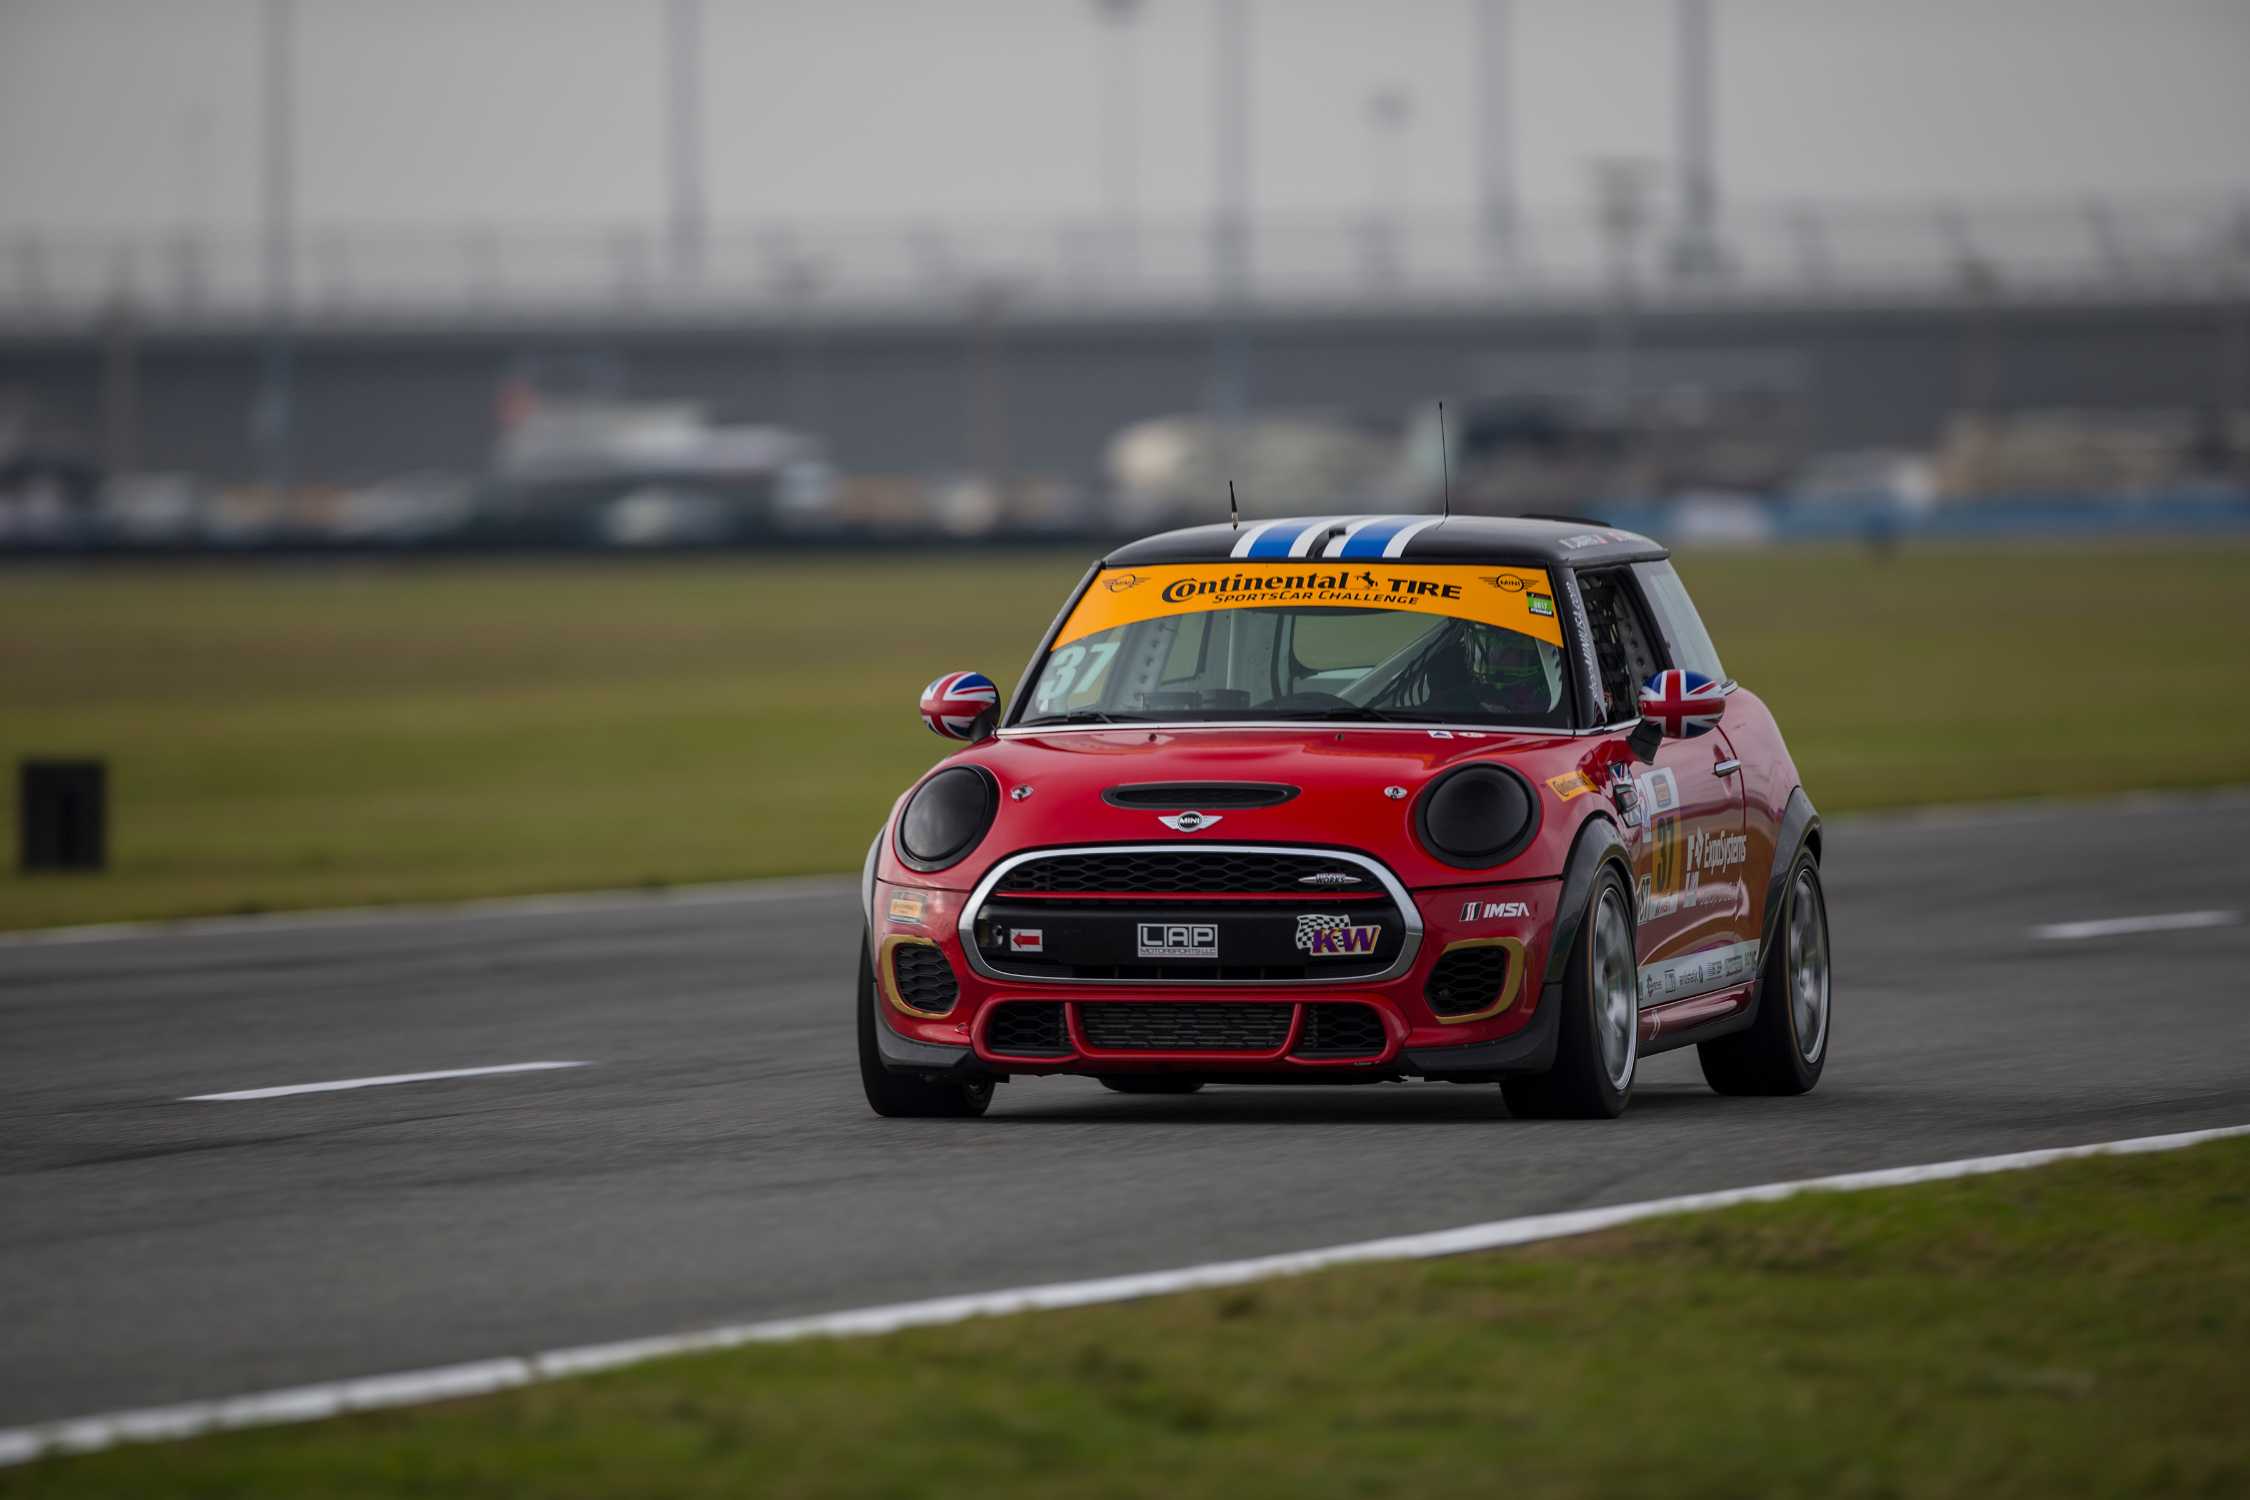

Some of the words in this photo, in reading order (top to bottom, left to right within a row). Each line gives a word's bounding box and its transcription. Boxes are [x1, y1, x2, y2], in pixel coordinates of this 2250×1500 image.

[1162, 571, 1348, 603] Continental
[1387, 578, 1462, 600] TIRE
[1318, 589, 1419, 605] CHALLENGE
[1037, 642, 1121, 702] 37
[1179, 816, 1200, 825] MINI
[1656, 815, 1675, 893] 37
[1703, 830, 1747, 876] ExpoSystems
[1483, 902, 1530, 918] IMSA
[1142, 927, 1214, 946] LAP
[1311, 926, 1379, 955] KW
